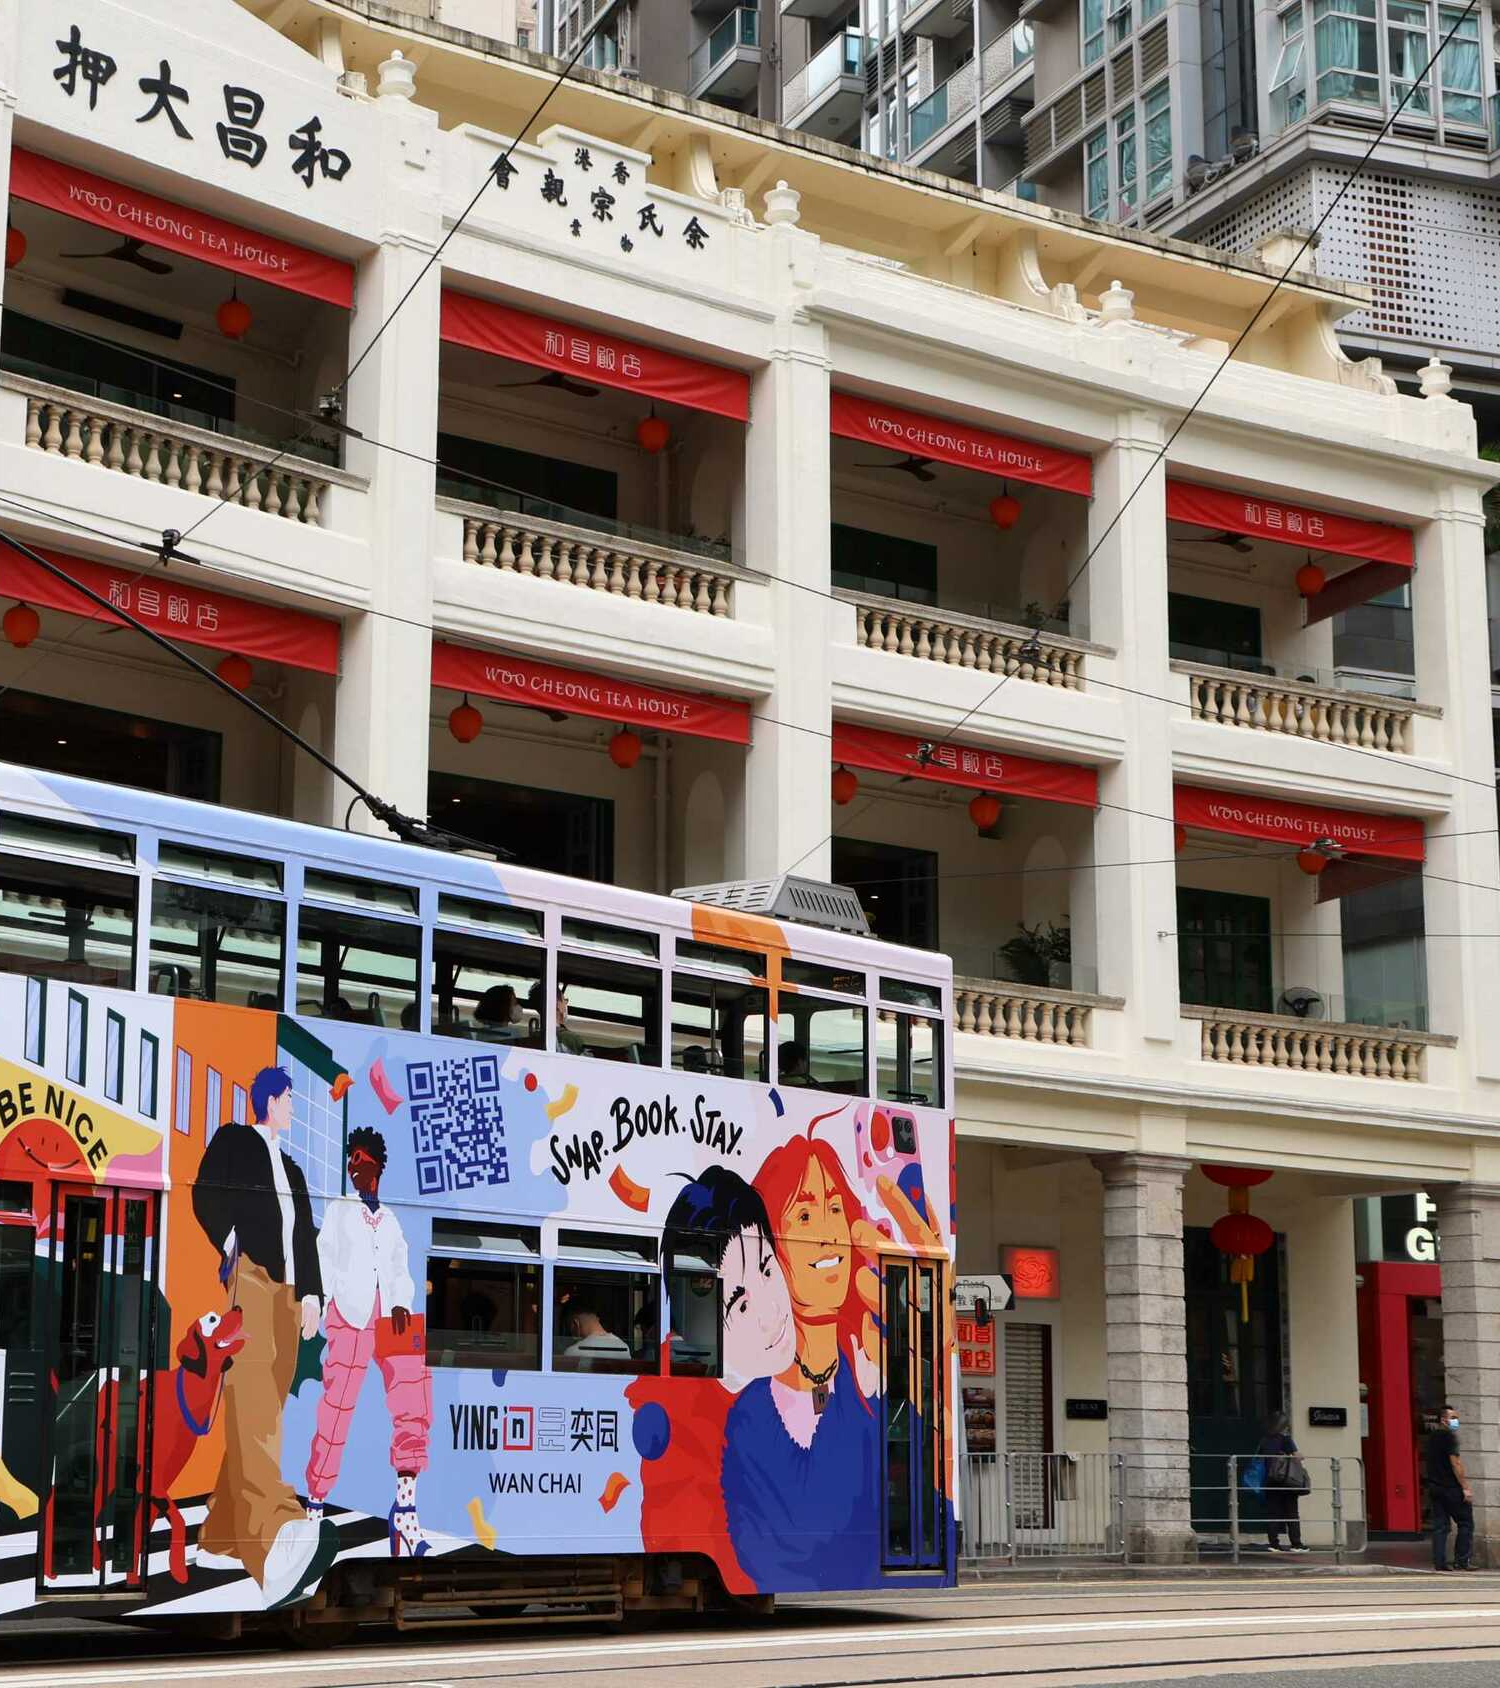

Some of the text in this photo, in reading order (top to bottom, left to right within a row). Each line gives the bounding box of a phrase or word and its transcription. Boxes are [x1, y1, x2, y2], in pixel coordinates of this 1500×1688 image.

[69, 184, 290, 273] WOO CHEONG TEA HOUSE
[867, 416, 1044, 472] WOO CHEONG TEA HOUSE
[485, 666, 691, 719] WOO CHEONG TEA HOUSE
[1208, 804, 1376, 842] WOO CHEONG TEA HOUSE
[44, 1084, 108, 1171] NICE
[489, 1473, 582, 1494] WAN CHAI
